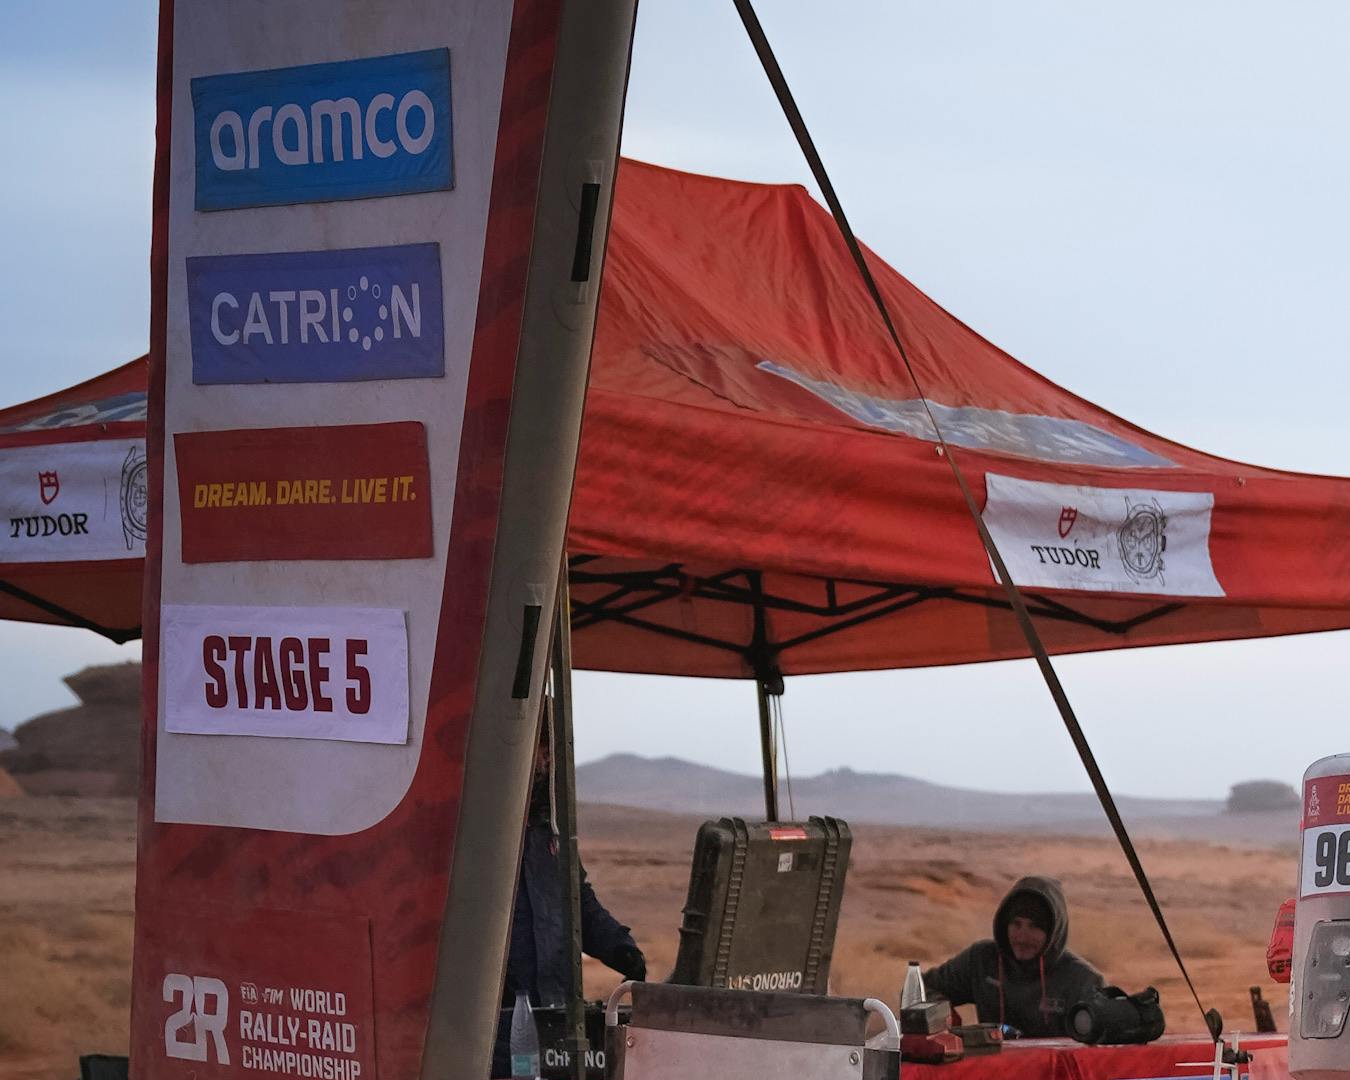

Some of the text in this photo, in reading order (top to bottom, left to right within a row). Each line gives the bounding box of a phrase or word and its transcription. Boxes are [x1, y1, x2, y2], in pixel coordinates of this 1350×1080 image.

[210, 88, 435, 171] aramco
[194, 476, 417, 508] DREAM. DARE. LIVE IT.
[10, 513, 89, 538] TUDOR
[1030, 544, 1101, 570] TUDOR
[203, 635, 371, 715] STAGE 5
[753, 971, 802, 991] CHRONO
[290, 987, 346, 1016] WORLD
[163, 973, 231, 1065] 2R
[240, 1010, 356, 1054] RALLY-RAID
